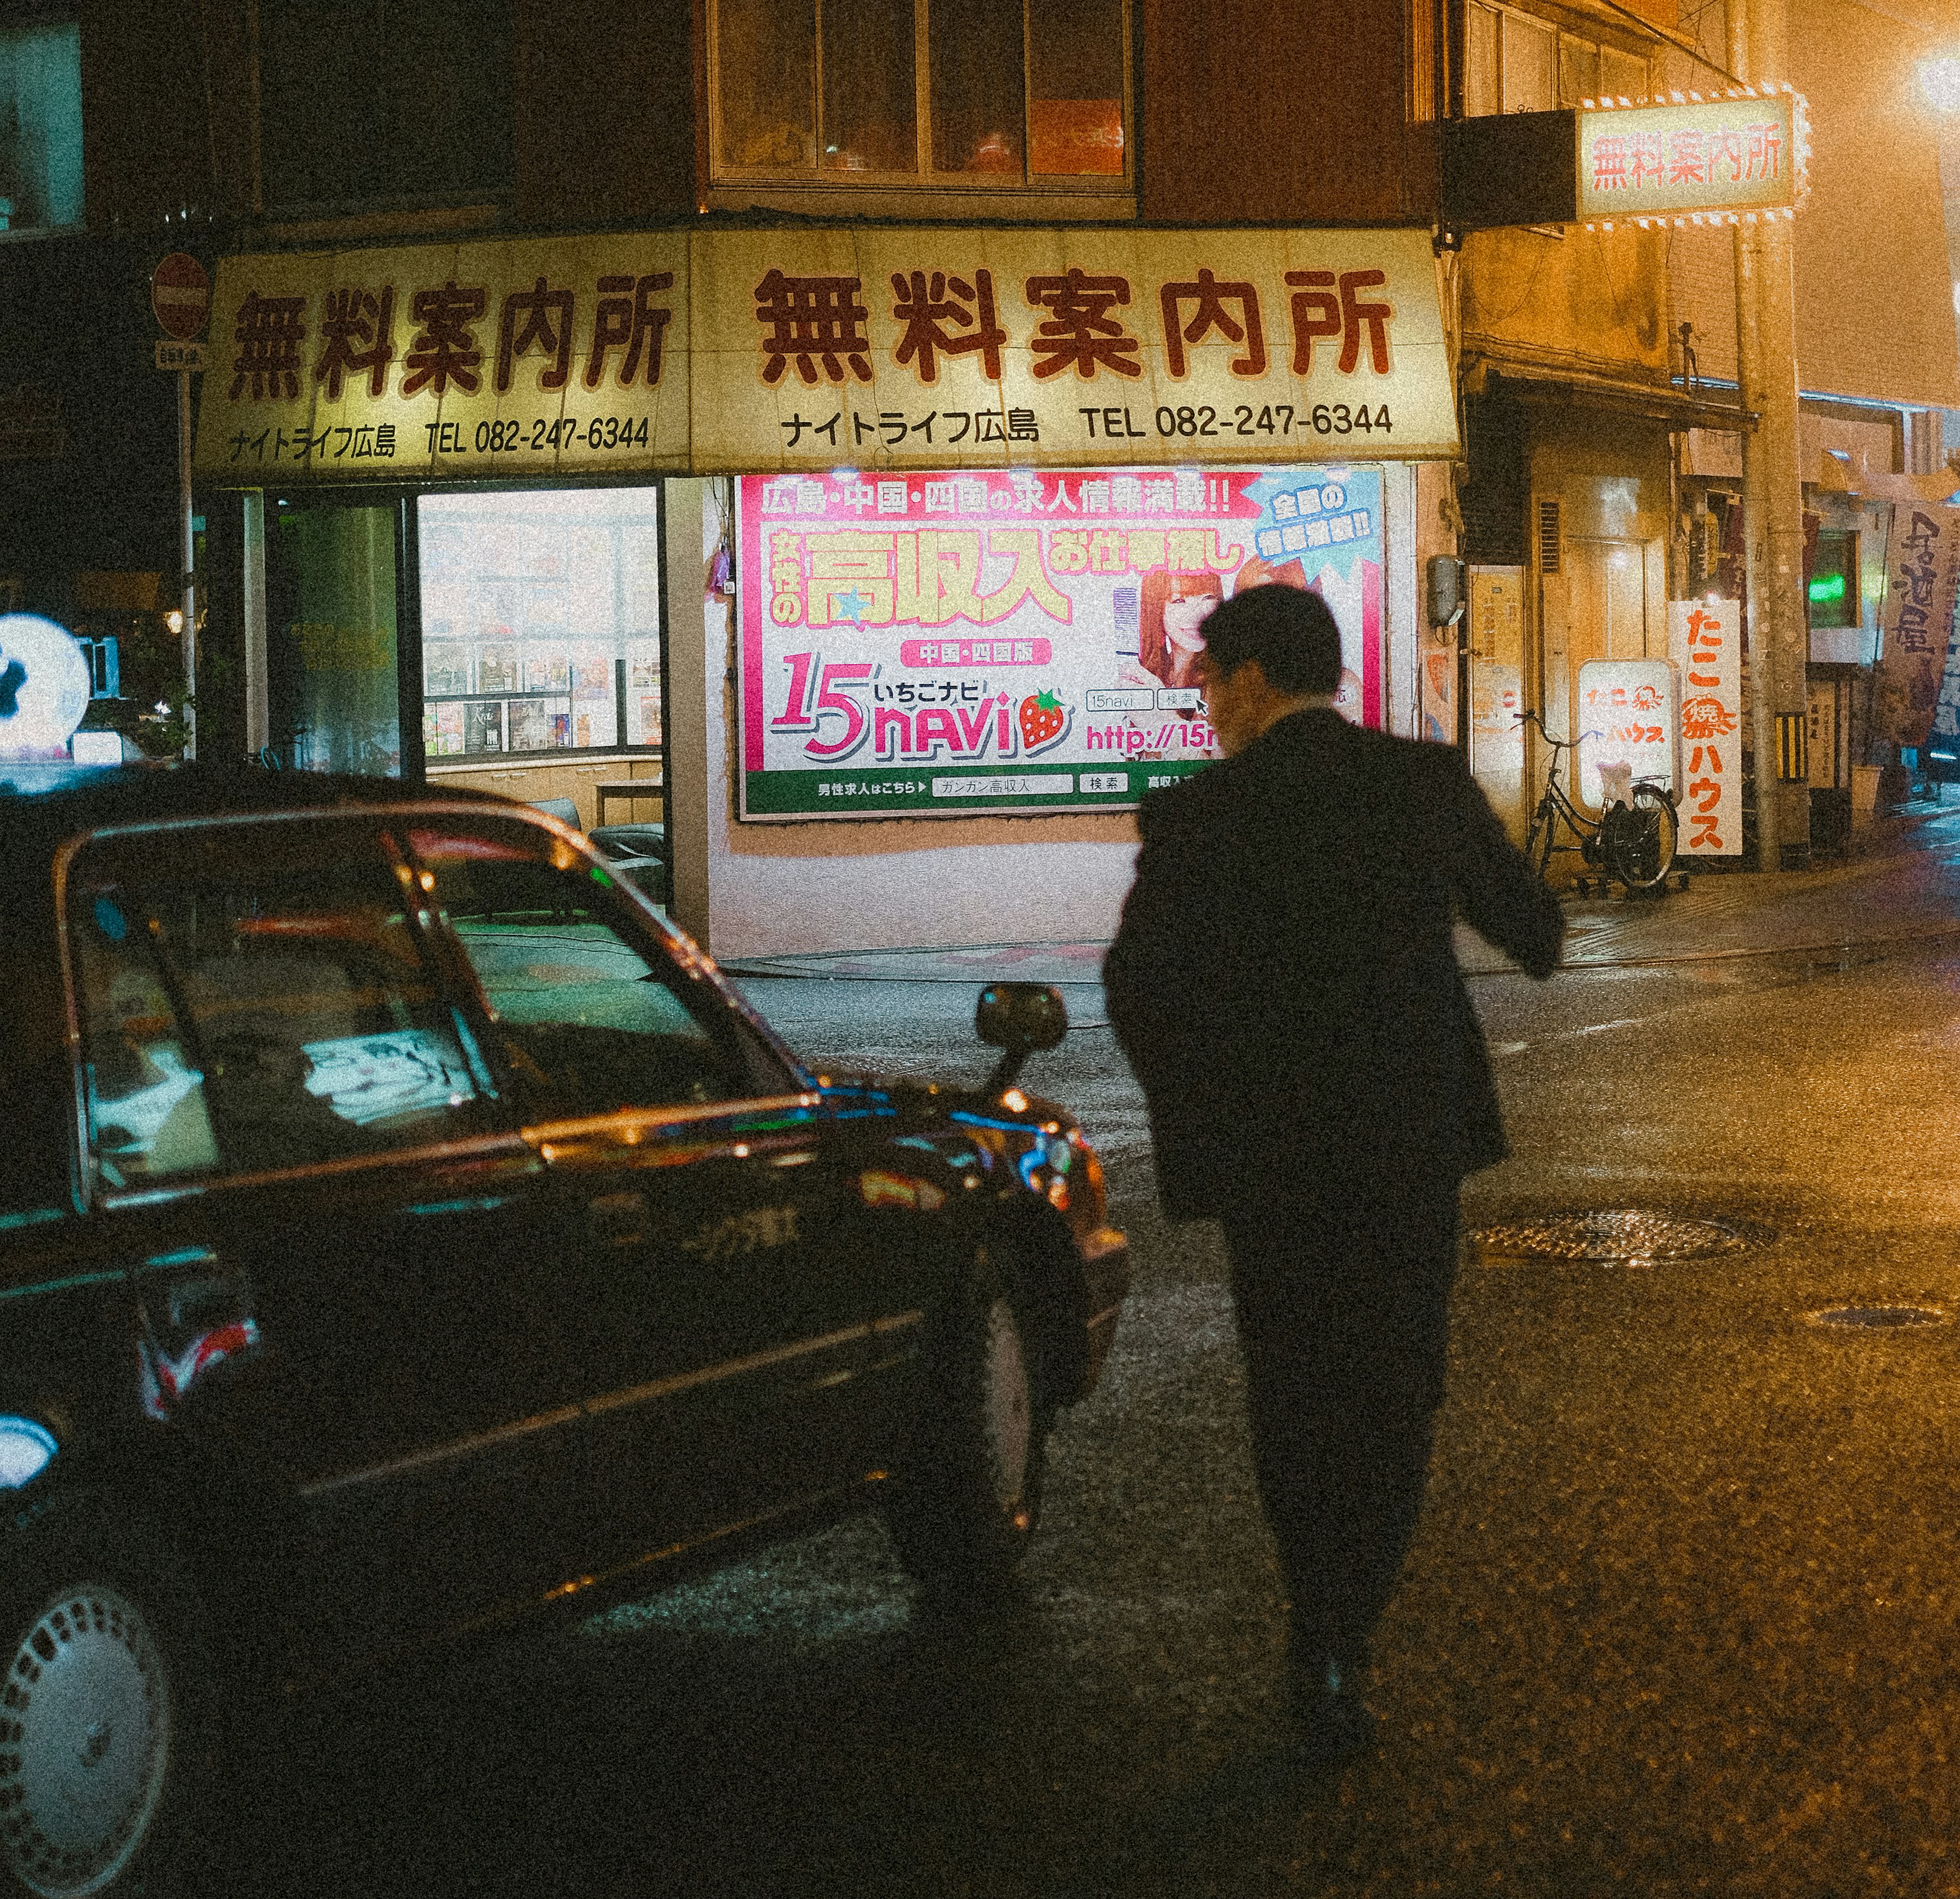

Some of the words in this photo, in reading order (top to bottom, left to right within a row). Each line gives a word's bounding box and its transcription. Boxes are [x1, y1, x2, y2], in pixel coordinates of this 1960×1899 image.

[1593, 123, 1782, 190] 無料案内所
[229, 270, 674, 401] 無料案内所
[754, 267, 1391, 384] 無料案内所
[230, 422, 396, 462] ナイトライフ広島
[425, 422, 467, 453] TEL
[475, 417, 649, 453] 082-247-6344
[781, 407, 1039, 447] ナイトライフ広島
[1078, 407, 1146, 438] TEL
[1155, 404, 1393, 438] 082-247-6344
[1272, 485, 1344, 520] 全国の
[772, 531, 802, 623] 女性の
[805, 529, 1070, 625] 高収入
[1050, 529, 1242, 572] お仕事探し
[919, 641, 1033, 664] 中国・四国版
[874, 680, 979, 702] いちごナビ
[1092, 694, 1133, 708] 15navi
[1167, 692, 1193, 706] 検索
[818, 781, 915, 796] 男性求人はこちら
[1089, 777, 1118, 790] 検索
[1148, 775, 1194, 789] 高収入
